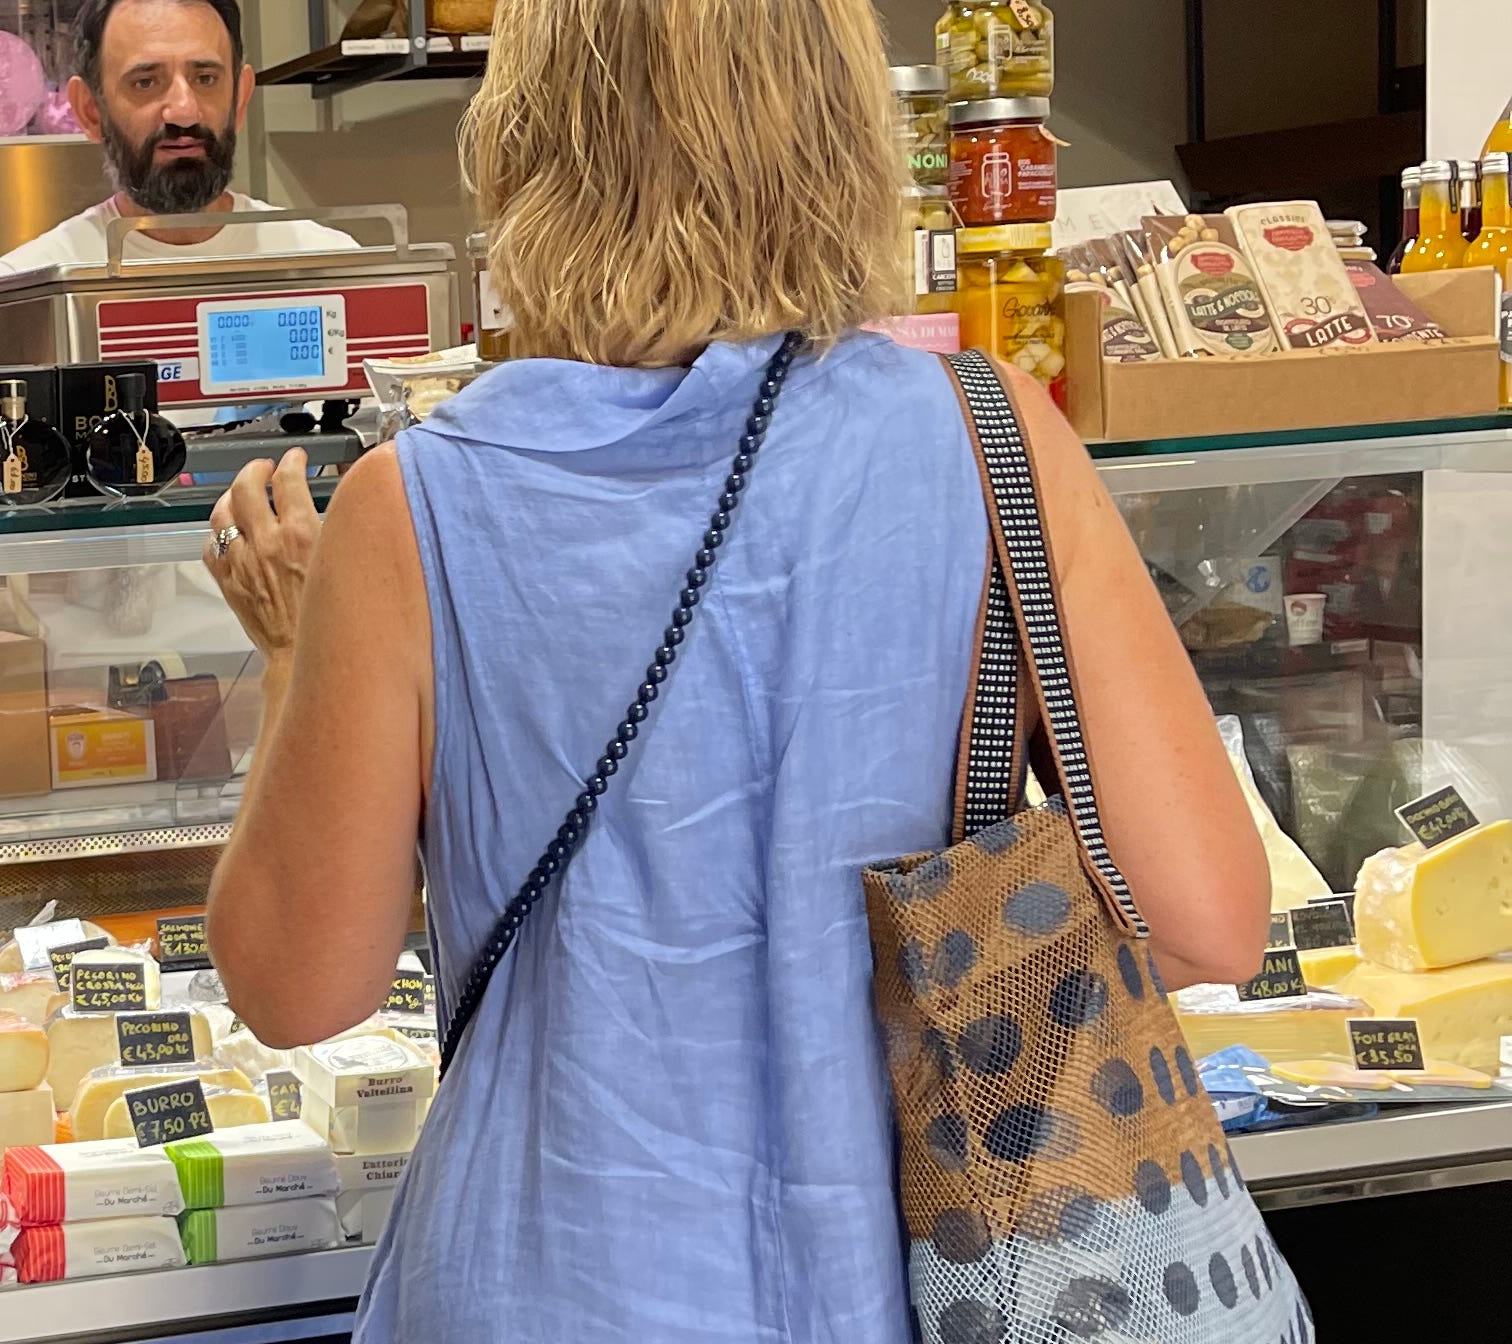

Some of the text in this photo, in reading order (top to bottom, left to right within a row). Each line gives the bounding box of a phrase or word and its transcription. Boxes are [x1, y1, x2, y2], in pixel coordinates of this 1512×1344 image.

[1305, 316, 1353, 347] LATTE
[367, 1075, 404, 1087] Burro
[270, 1082, 302, 1097] CAR
[356, 1085, 414, 1099] Valtellina
[132, 1092, 195, 1116] BURRO
[362, 1157, 409, 1170] Latteri
[366, 1166, 400, 1181] Chiur
[262, 1183, 306, 1194] Du Marché
[104, 1195, 148, 1206] Du Marché
[254, 1233, 297, 1245] Du Marché
[103, 1252, 147, 1263] Du Marché
